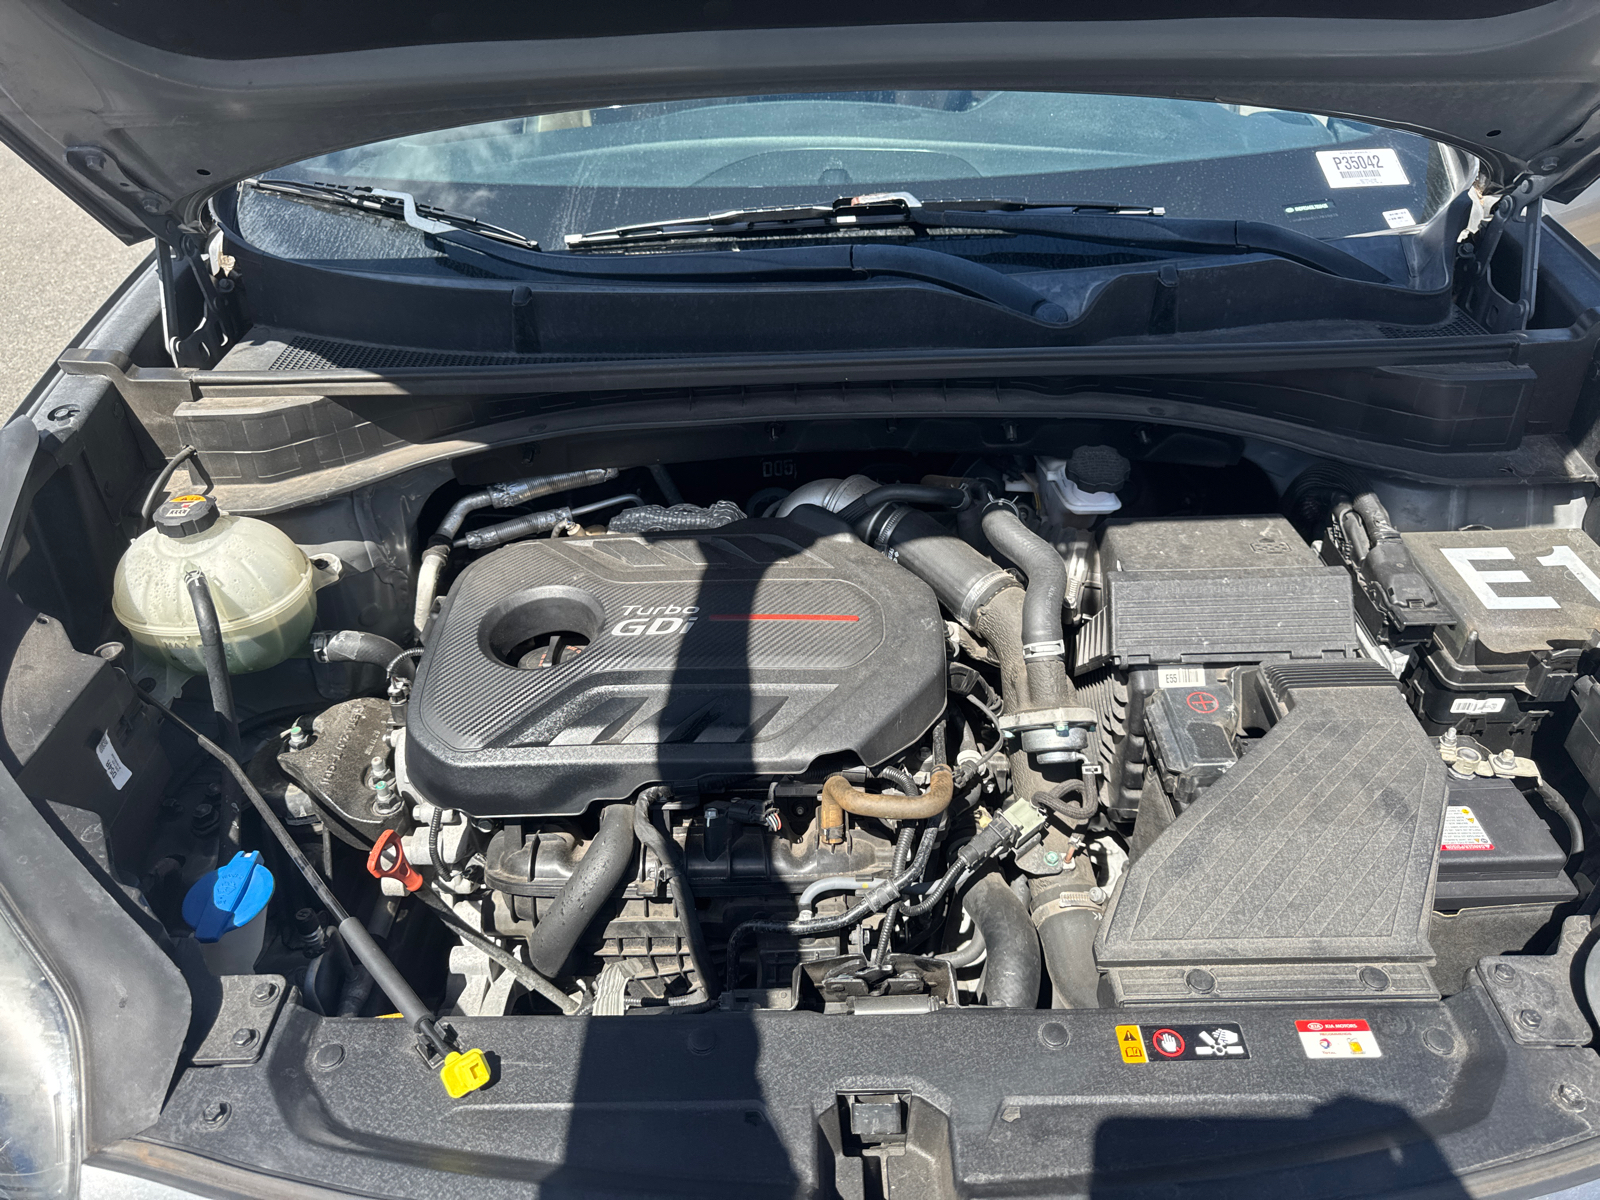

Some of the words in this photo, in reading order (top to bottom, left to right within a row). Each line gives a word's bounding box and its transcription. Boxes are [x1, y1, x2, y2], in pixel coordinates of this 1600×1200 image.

[1332, 155, 1384, 170] P35042
[1440, 546, 1600, 609] E1
[622, 604, 700, 616] Turbo
[611, 616, 698, 635] GDi
[163, 641, 189, 650] MAX
